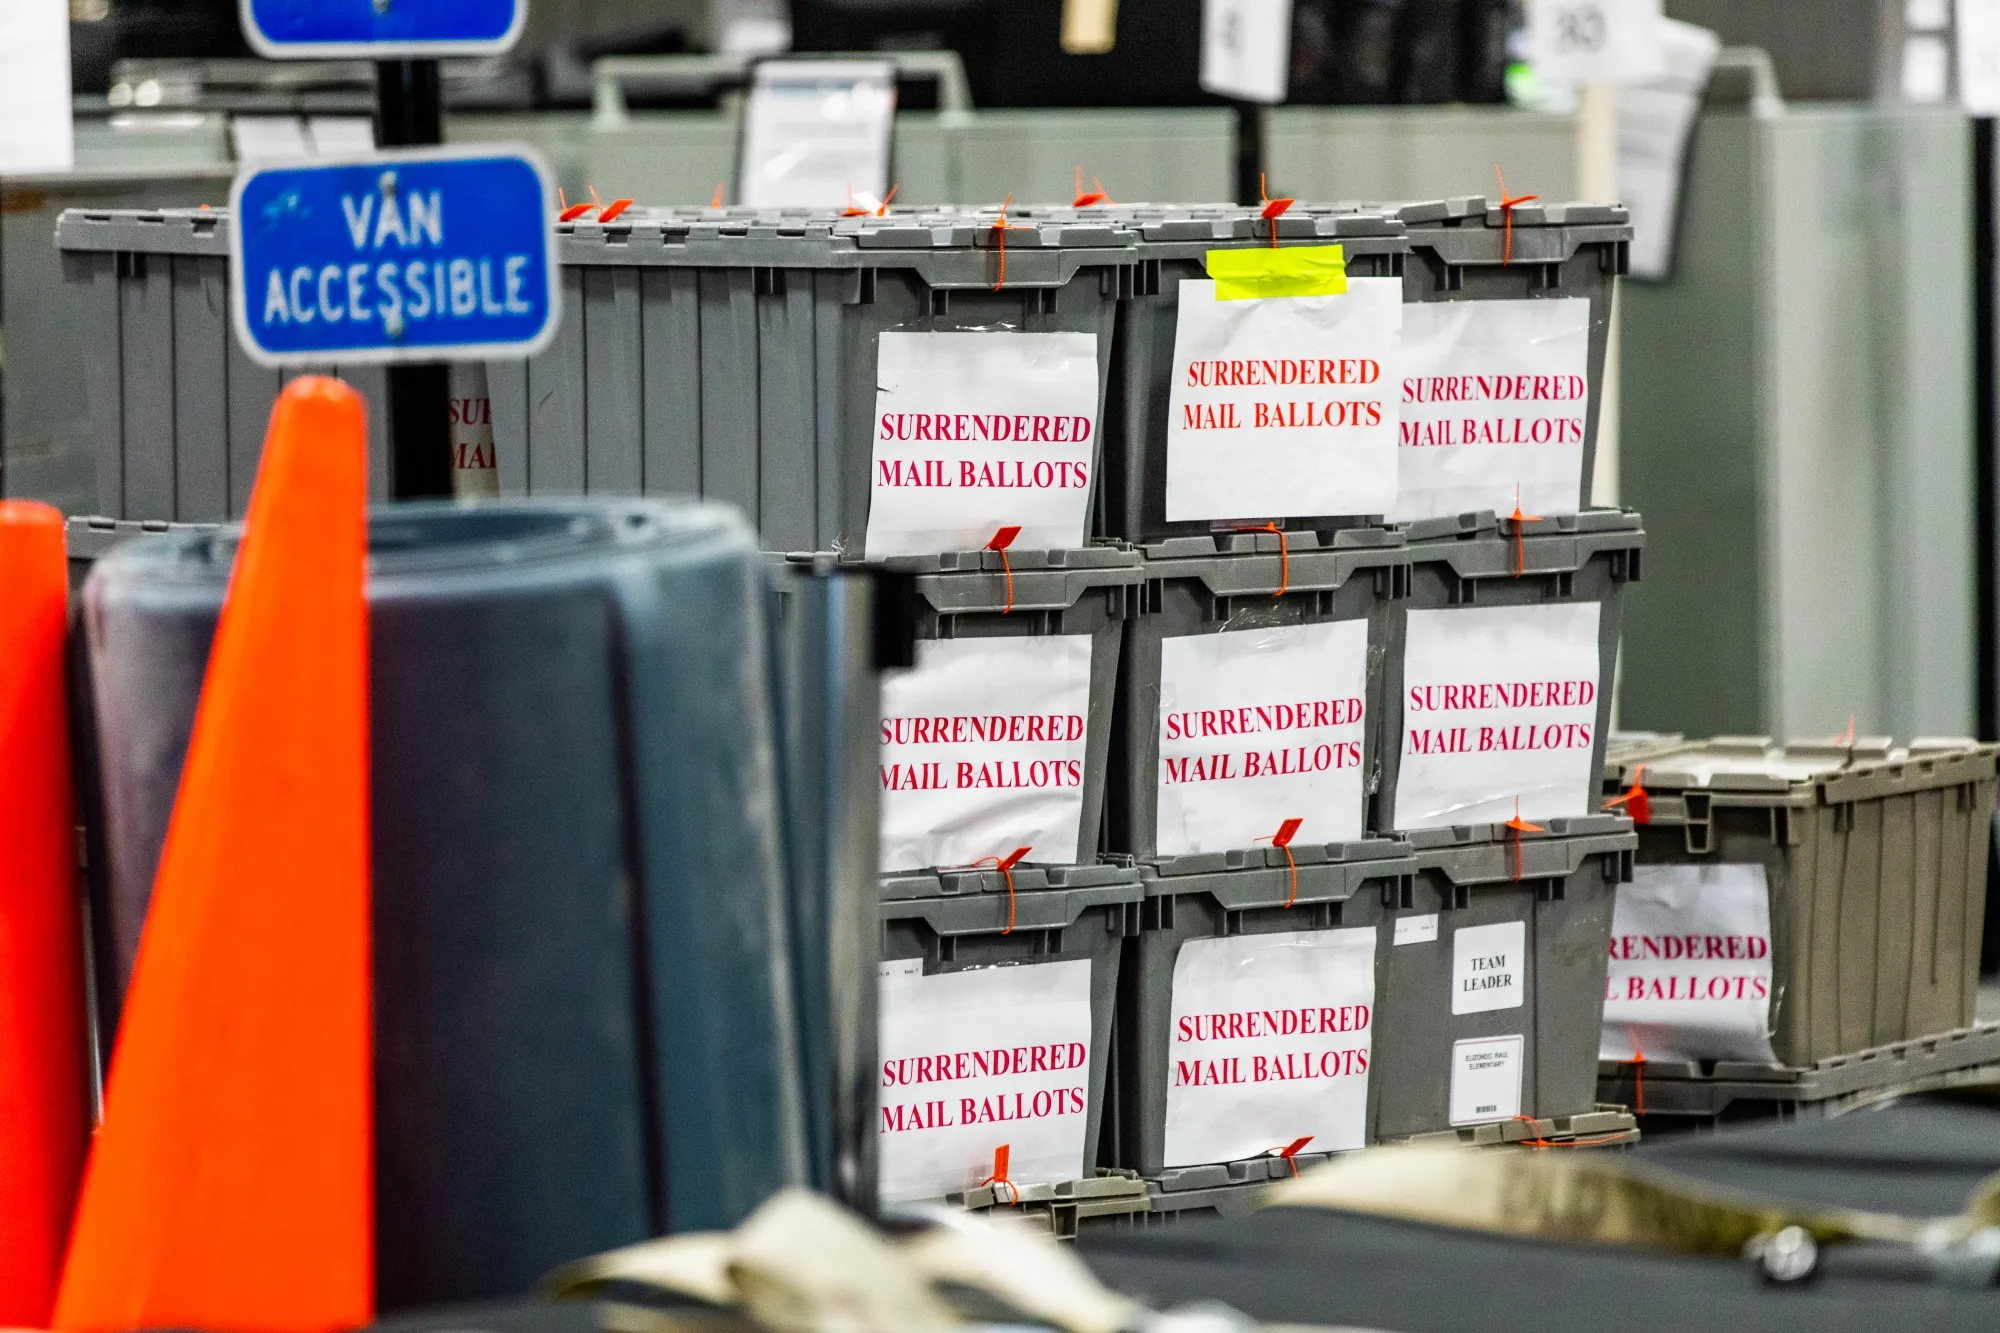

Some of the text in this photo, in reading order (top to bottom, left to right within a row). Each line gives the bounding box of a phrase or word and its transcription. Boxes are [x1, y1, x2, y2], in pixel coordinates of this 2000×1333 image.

[342, 189, 443, 250] VAN
[263, 254, 532, 325] ACCESSIBLE
[1187, 359, 1380, 387] SURRENDERED
[1402, 375, 1584, 403] SURRENDERED
[880, 413, 1091, 443] SURRENDERED
[1182, 401, 1381, 430] MAIL BALLOTS
[1399, 418, 1582, 447] MAIL BALLOTS
[877, 460, 1087, 489] MAIL BALLOTS
[1410, 680, 1594, 711] SURRENDERED
[880, 715, 1084, 745] SURRENDERED
[1166, 698, 1363, 740] SURRENDERED
[1407, 724, 1591, 755] MAIL BALLOTS
[879, 759, 1081, 791] MAIL BALLOTS
[1165, 741, 1361, 784] MAIL BALLOTS
[1471, 955, 1505, 971] TEAM
[1463, 974, 1512, 992] LEADER
[1626, 976, 1767, 1001] BALLOTS
[1177, 1005, 1369, 1042] SURRENDERED
[882, 1042, 1086, 1087] SURRENDERED
[1174, 1048, 1368, 1087] MAIL BALLOTS
[1469, 1061, 1505, 1070] ELEMENTARY
[880, 1087, 1084, 1134] MAIL BALLOTS
